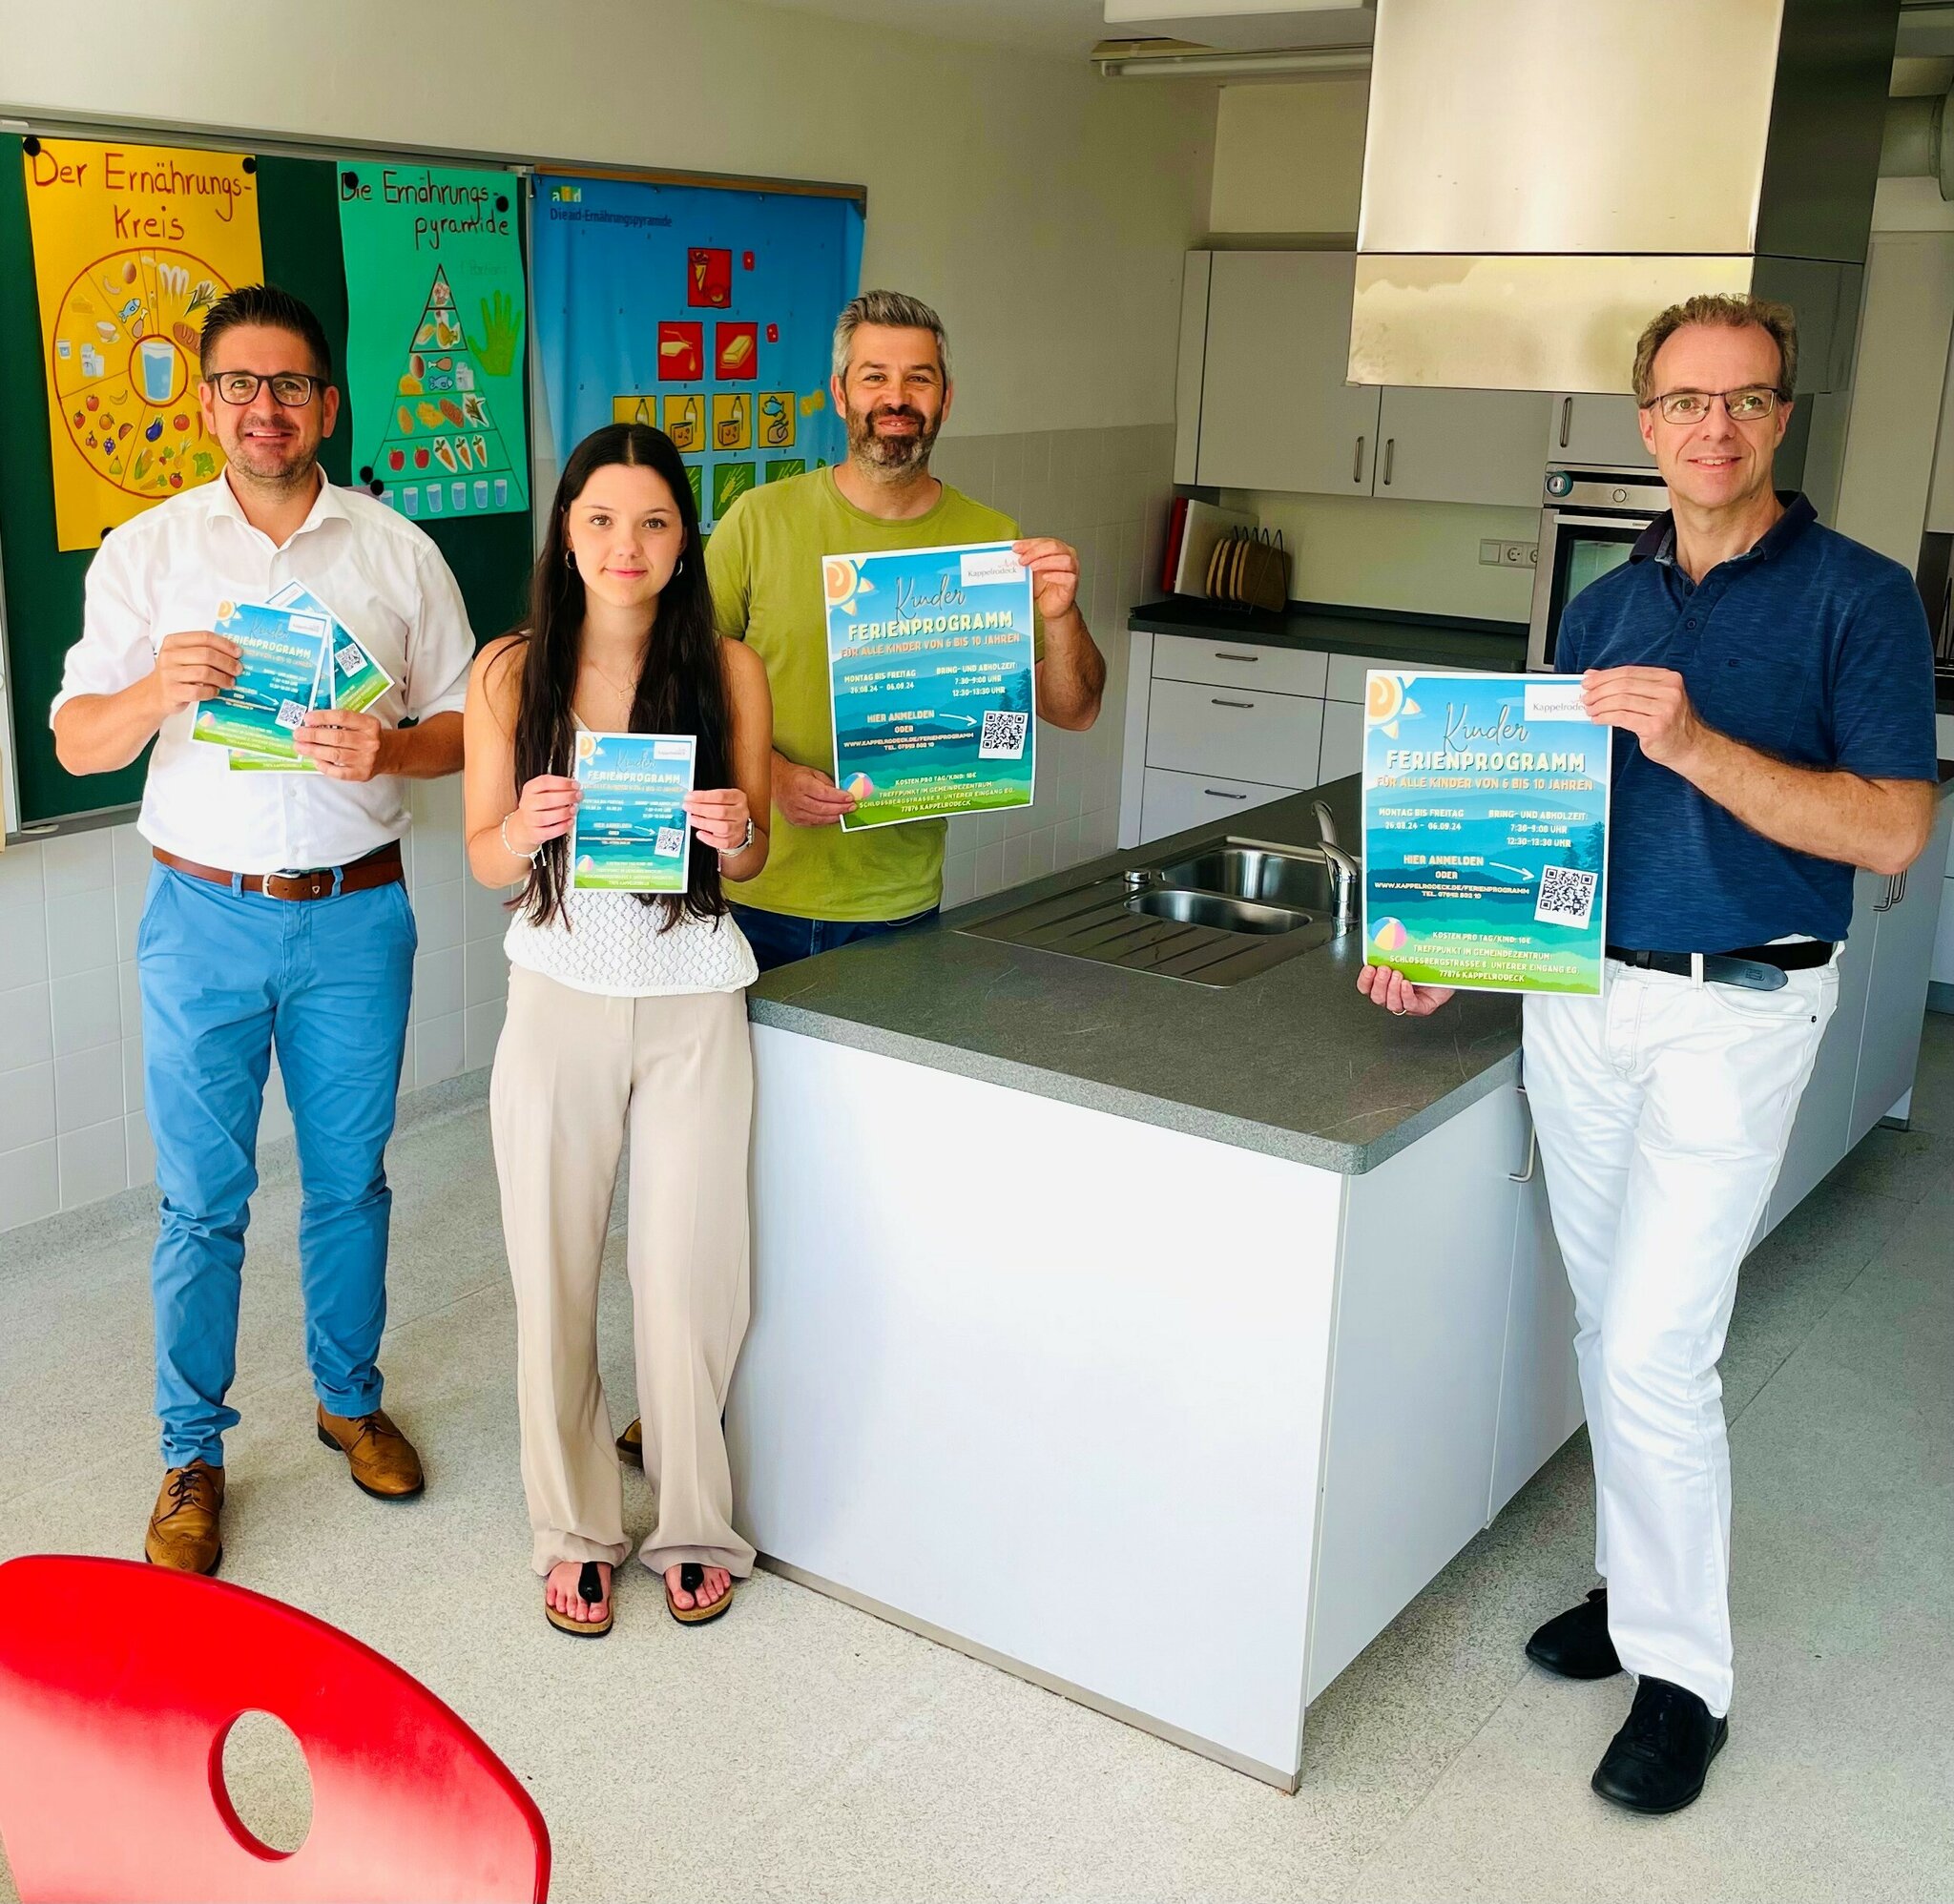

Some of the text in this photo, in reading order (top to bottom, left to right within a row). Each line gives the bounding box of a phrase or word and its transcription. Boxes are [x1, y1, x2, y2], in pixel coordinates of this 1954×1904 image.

[31, 149, 252, 221] Der Ernährungs-
[341, 170, 499, 225] Die Ernährungs-
[550, 208, 567, 220] Die
[114, 204, 185, 240] Kreis
[415, 209, 509, 250] pyramide
[895, 573, 966, 624] Kinder
[848, 611, 1013, 642] FERIENPROGRAMM
[840, 633, 1020, 658] FÜR ALLE KINDER VON 6 BIS 10 JAHREN
[936, 667, 962, 675] BRING-
[963, 665, 977, 673] UND
[843, 670, 917, 683] MONTAG BIS FREITAG
[987, 674, 1002, 684] UHR
[991, 686, 1006, 694] UHR
[1532, 702, 1586, 714] Kappelrode
[867, 710, 935, 723] HIER ANMELDEN
[894, 725, 914, 734] ODER
[1442, 701, 1529, 757] Kinder
[1386, 750, 1586, 773] FERIENPROGRAMM
[588, 771, 681, 784] FERIENPROGRAMM
[1376, 776, 1594, 791] FÜR ALLE KINDER VON 6 BIS 10 JAHREN
[879, 788, 920, 798] TREFFPUNKT
[944, 791, 973, 800] UNTERER
[974, 788, 1003, 797] EINGANG
[920, 799, 971, 811] KAPPELRODECK
[1379, 808, 1413, 817] MONTAG
[1429, 809, 1465, 817] FREITAG
[1488, 809, 1518, 818] BRING-
[1520, 811, 1538, 819] UND
[1550, 825, 1568, 834] UHR
[1553, 838, 1571, 848] UHR
[1403, 854, 1485, 866] HIER ANMELDEN
[1435, 870, 1458, 880] ODER
[1432, 931, 1462, 941] KOSTEN
[1413, 944, 1462, 955] TREFFPUNKT
[1389, 955, 1480, 968] SCHLOSSBERGSTRASSE
[1490, 961, 1527, 971] UNTERER
[1529, 963, 1565, 974] EINGANG
[1439, 969, 1525, 983] 77876 KAPPELRODECK
